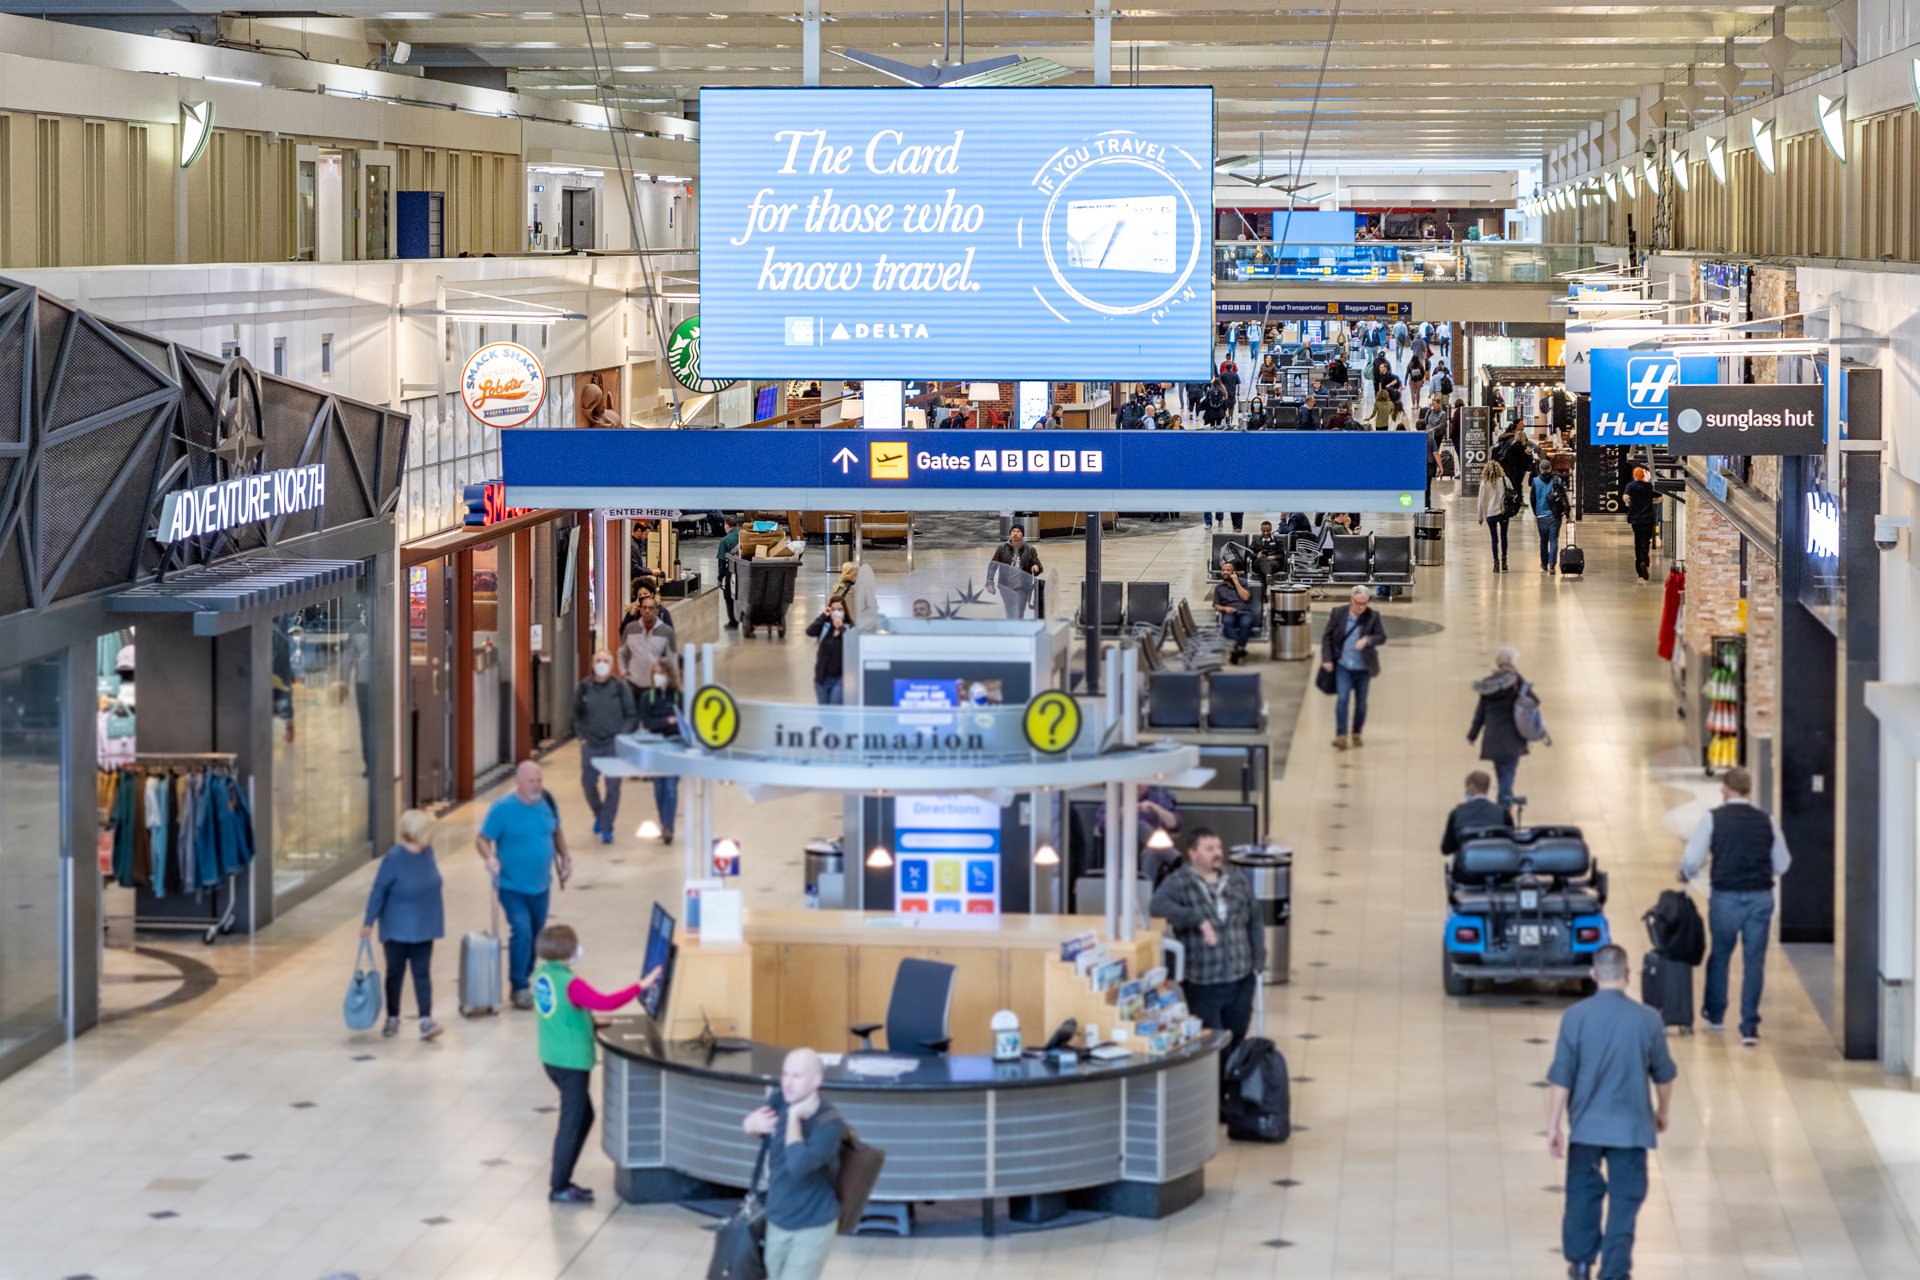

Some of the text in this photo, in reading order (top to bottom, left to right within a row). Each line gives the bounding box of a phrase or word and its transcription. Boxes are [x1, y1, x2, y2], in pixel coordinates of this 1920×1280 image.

[774, 129, 964, 174] The Card
[1038, 138, 1165, 195] IF YOU TRAVEL
[730, 188, 984, 246] for those who
[757, 246, 980, 291] know travel.
[1286, 304, 1326, 312] Transportation
[1345, 304, 1368, 312] Baggage
[855, 323, 929, 339] DELTA
[467, 349, 539, 389] SMACK SHACK
[482, 368, 520, 378] GENUINE
[472, 377, 529, 409] Lobster
[1706, 409, 1814, 432] sunglass hut
[917, 452, 970, 470] Gates
[1465, 450, 1486, 464] 90
[168, 464, 325, 543] ADVENTURE NORTH
[609, 508, 674, 517] ENTER HERE
[775, 724, 984, 750] information
[913, 801, 981, 815] Directions
